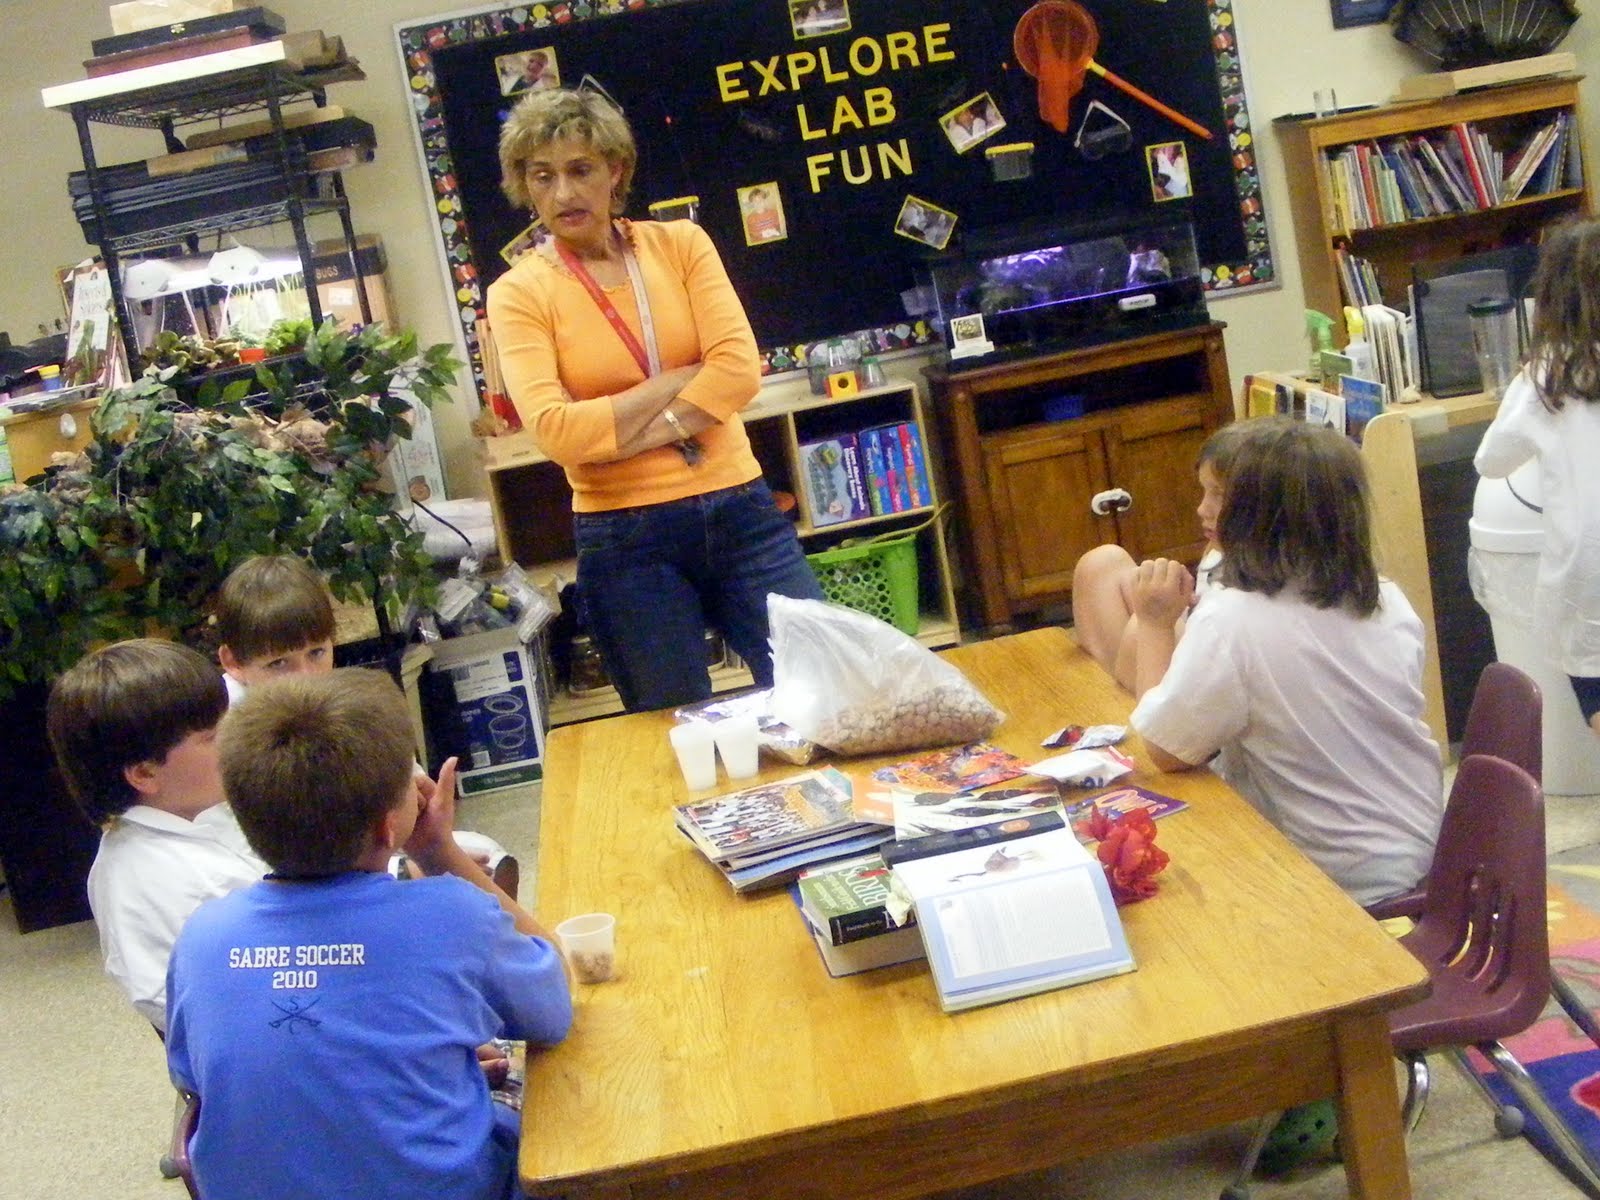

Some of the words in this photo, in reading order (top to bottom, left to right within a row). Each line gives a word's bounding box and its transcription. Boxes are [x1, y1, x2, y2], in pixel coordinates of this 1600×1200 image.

[716, 23, 956, 103] EXPLORE
[797, 86, 896, 141] LAB
[806, 138, 913, 193] FUN
[843, 447, 853, 478] Discovery
[853, 466, 861, 485] About
[857, 485, 865, 511] Animals
[838, 865, 888, 906] BIRDS
[229, 945, 291, 969] SABRE
[295, 943, 365, 967] SOCCER
[272, 970, 318, 989] 2010
